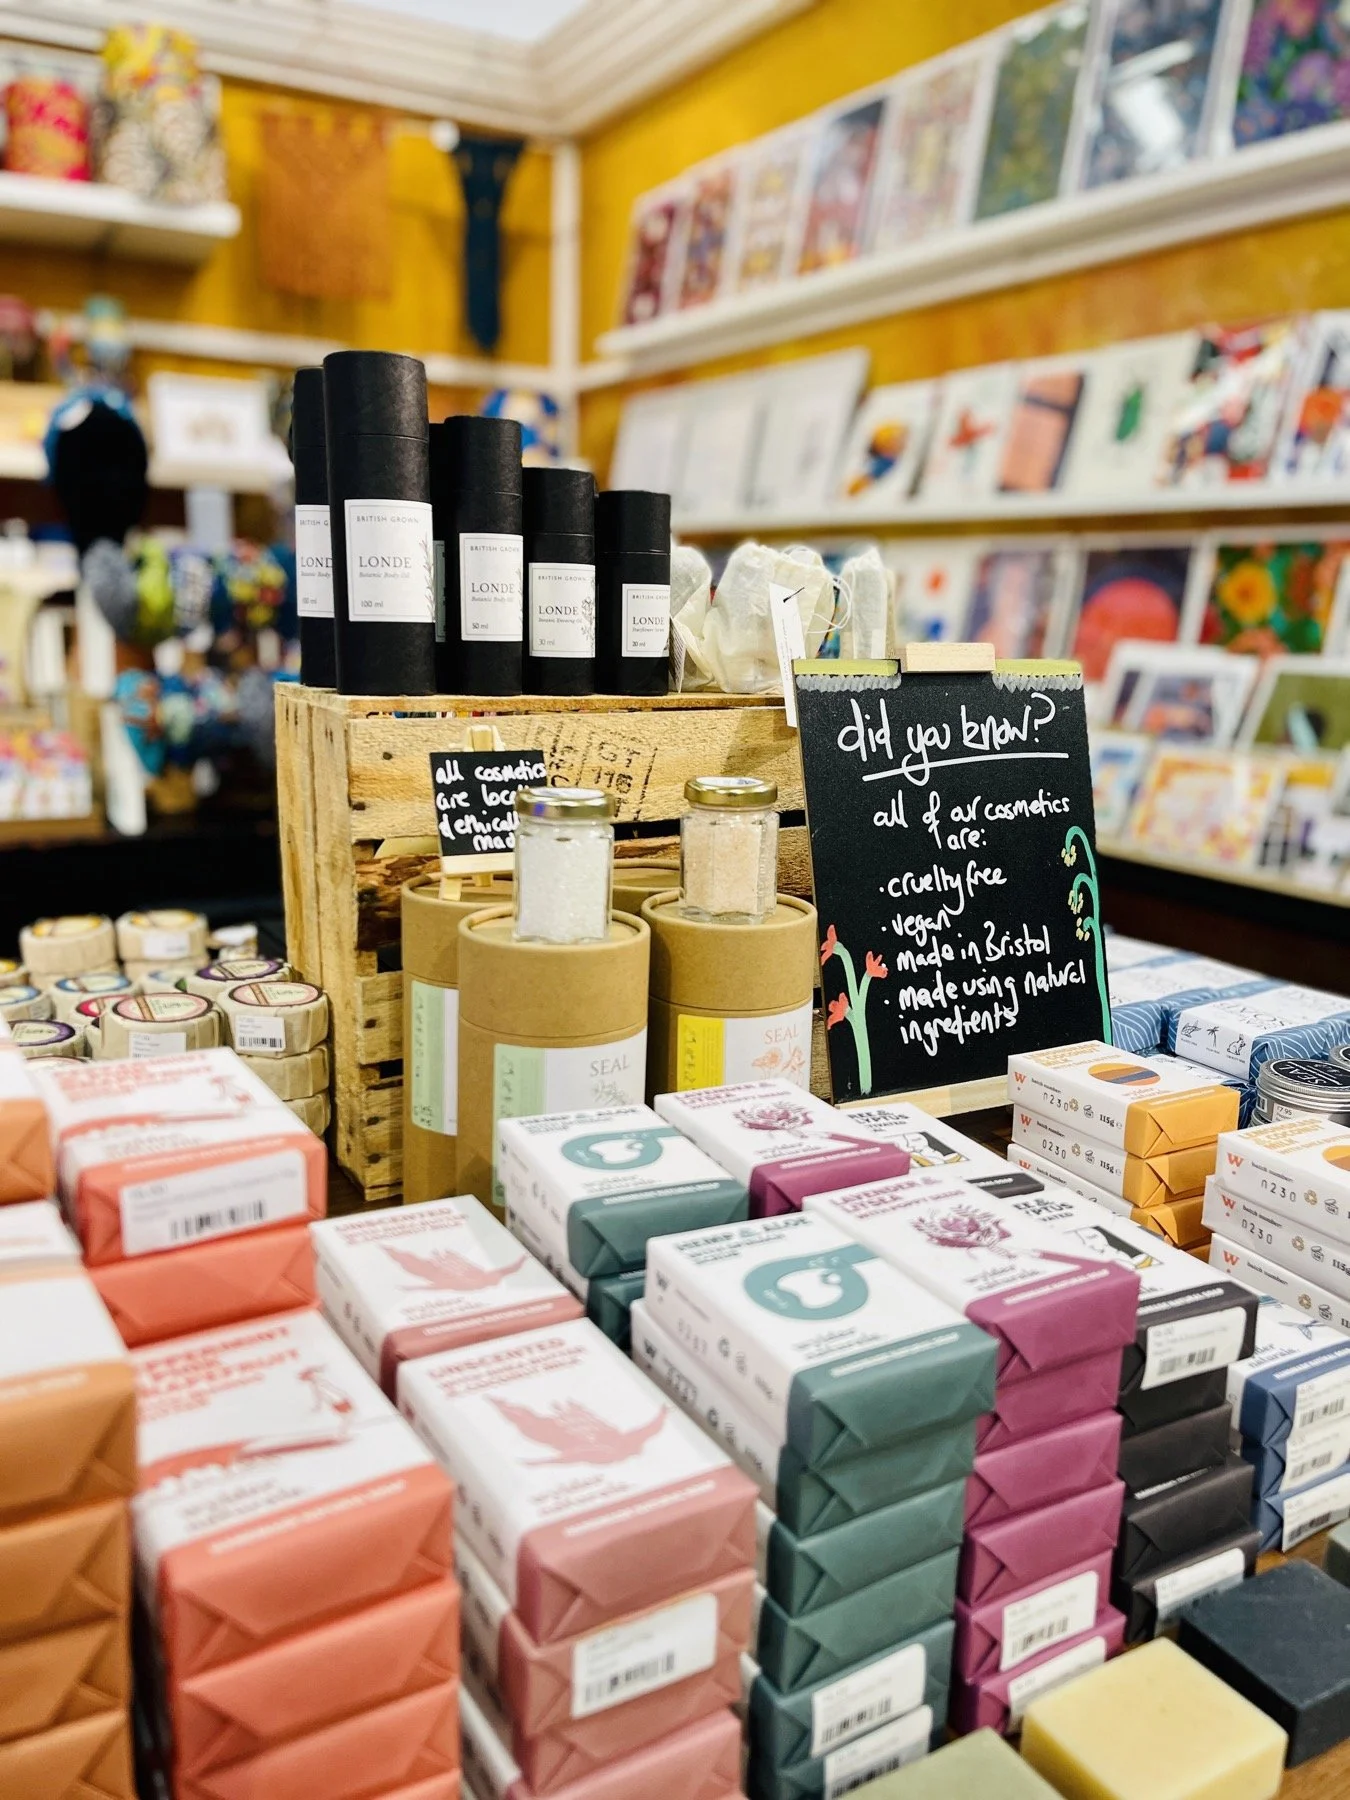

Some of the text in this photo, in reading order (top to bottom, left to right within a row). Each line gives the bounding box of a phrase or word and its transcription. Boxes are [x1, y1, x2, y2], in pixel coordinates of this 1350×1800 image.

[356, 515, 419, 524] BRITISH GROWN
[358, 555, 412, 569] LONDE
[471, 581, 515, 594] LONDE
[374, 600, 384, 608] ml
[538, 604, 579, 616] LONDE
[631, 615, 665, 626] LONDE
[837, 691, 1057, 787] did you know?
[436, 759, 548, 785] all cosmetics
[436, 790, 471, 811] are
[453, 807, 521, 835] ethicall
[873, 789, 909, 828] all
[921, 790, 943, 850] of
[983, 788, 1071, 821] cosmetics
[472, 831, 517, 852] mad
[946, 827, 988, 851] are:
[887, 859, 1008, 916] cruelty free
[891, 909, 951, 947] vegan
[896, 920, 1051, 973] made in Bristol
[898, 958, 1087, 1017] made using natural
[763, 1024, 801, 1045] SEAL
[898, 1000, 1018, 1057] ingredients
[589, 1054, 630, 1077] SEAL
[1014, 1071, 1027, 1084] W
[1278, 1064, 1328, 1085] SEAL
[846, 1111, 877, 1120] REE
[854, 1113, 911, 1125] LYPTUS
[1020, 1113, 1032, 1126] W
[1099, 1114, 1115, 1128] 115g
[1042, 1138, 1067, 1160] 0230
[1099, 1159, 1115, 1174] 115g
[1226, 1152, 1244, 1169] W
[1012, 1200, 1037, 1210] EE
[1221, 1194, 1237, 1210] W
[1039, 1212, 1074, 1222] VATED
[1222, 1250, 1240, 1267] W
